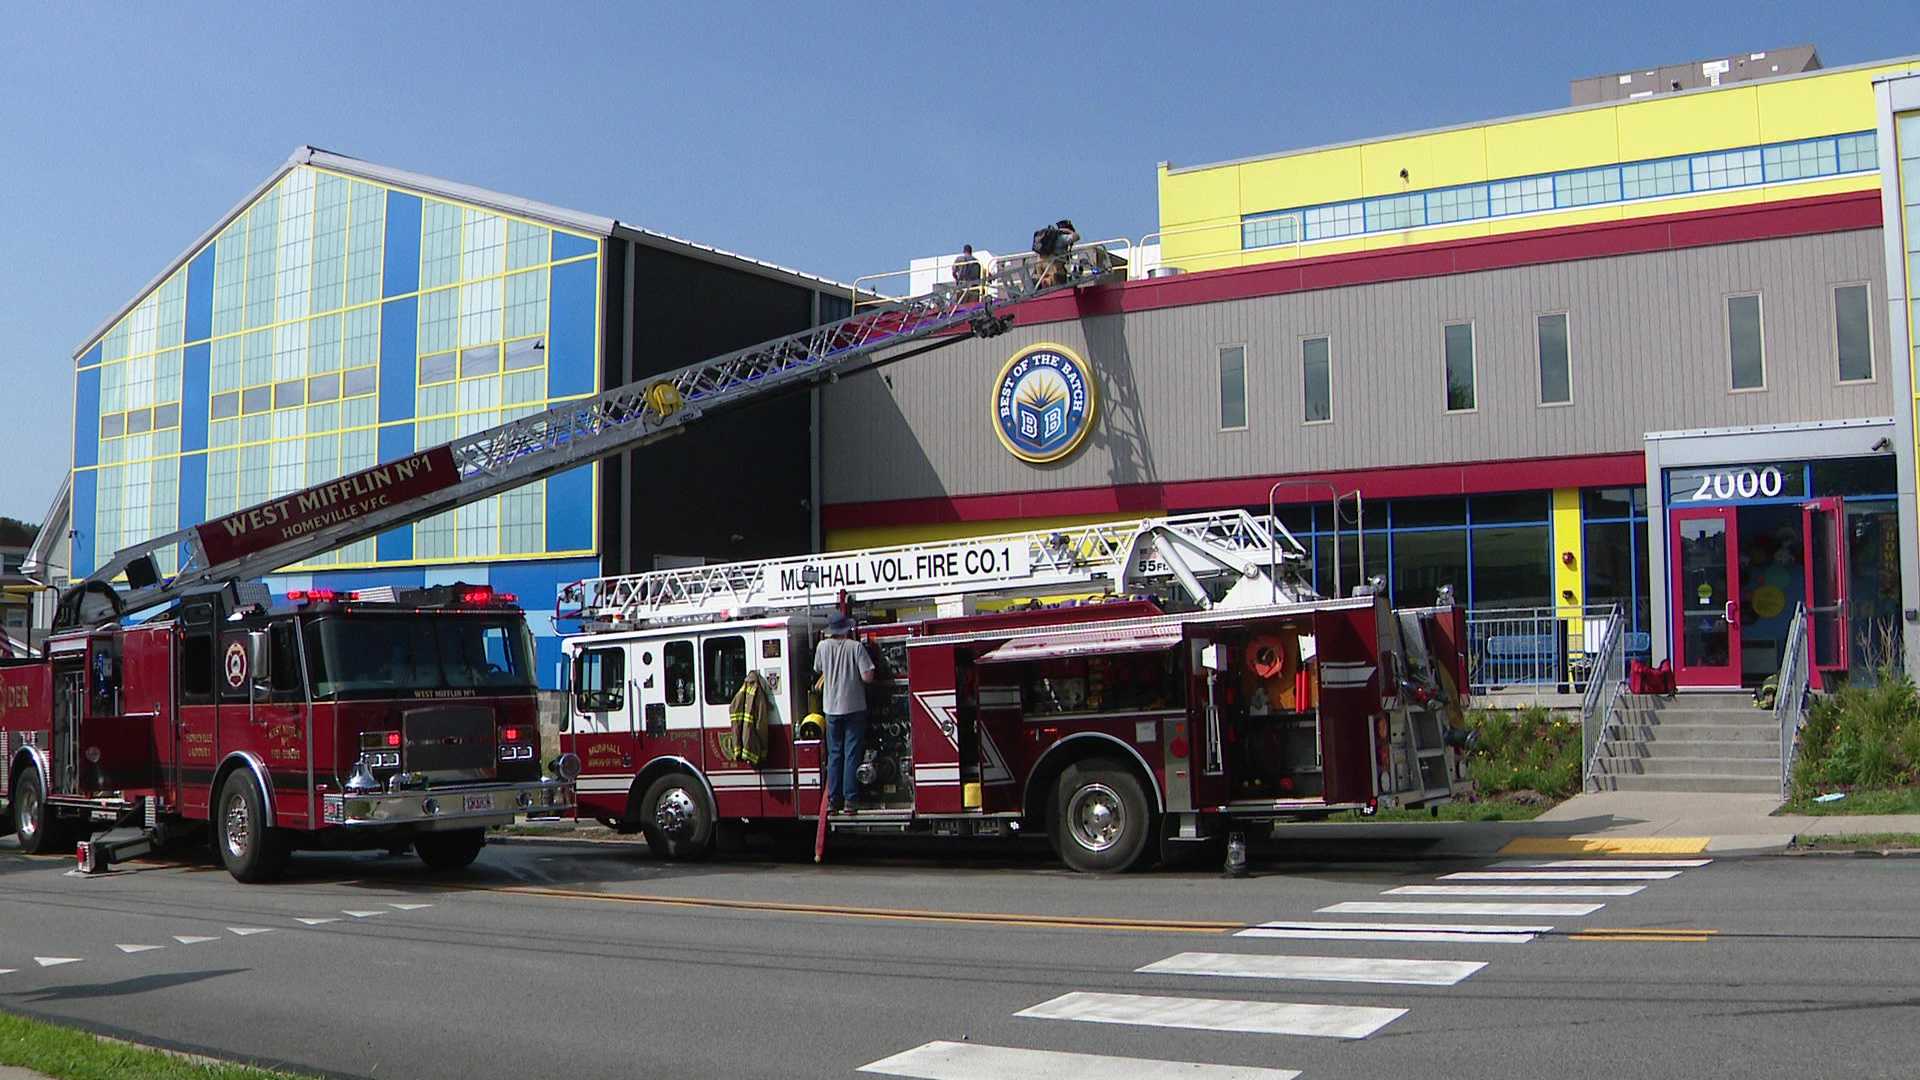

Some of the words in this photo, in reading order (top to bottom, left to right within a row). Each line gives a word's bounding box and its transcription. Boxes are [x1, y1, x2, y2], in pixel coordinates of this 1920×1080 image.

[1001, 378, 1015, 418] BEST
[1013, 360, 1029, 377] OF
[1032, 355, 1060, 366] THE
[1061, 363, 1084, 412] BATCH
[1692, 466, 1782, 500] 2000
[223, 501, 290, 537] WEST
[297, 468, 392, 514] MIFFLIN
[282, 505, 359, 539] HOMEVILLE
[361, 494, 389, 516] VFC
[870, 557, 913, 583] VOL.
[916, 552, 958, 579] FIRE
[1139, 560, 1156, 572] 55
[415, 689, 433, 698] WEST
